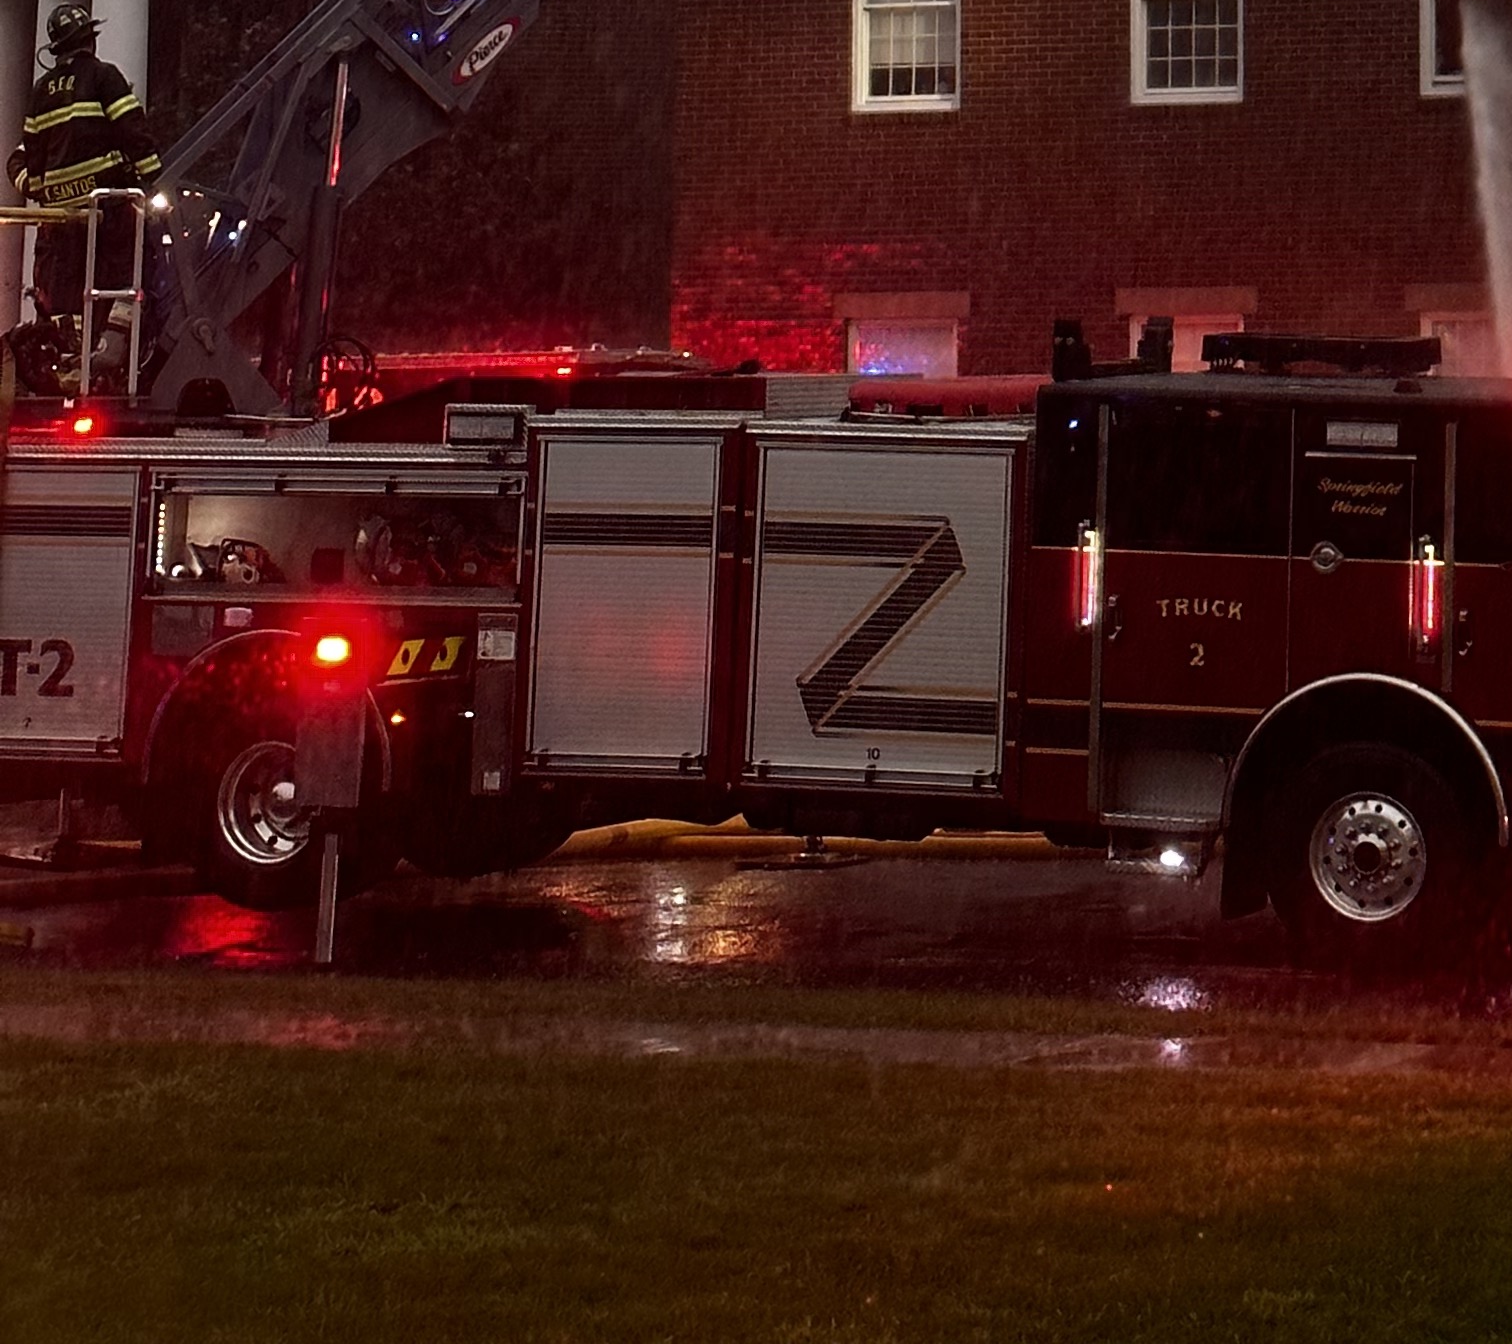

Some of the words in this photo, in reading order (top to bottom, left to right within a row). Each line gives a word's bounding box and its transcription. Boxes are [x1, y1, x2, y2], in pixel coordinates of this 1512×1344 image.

[468, 30, 508, 72] Pierce
[1156, 598, 1244, 621] TRUCK
[1189, 643, 1205, 666] 2
[866, 747, 881, 760] 10
